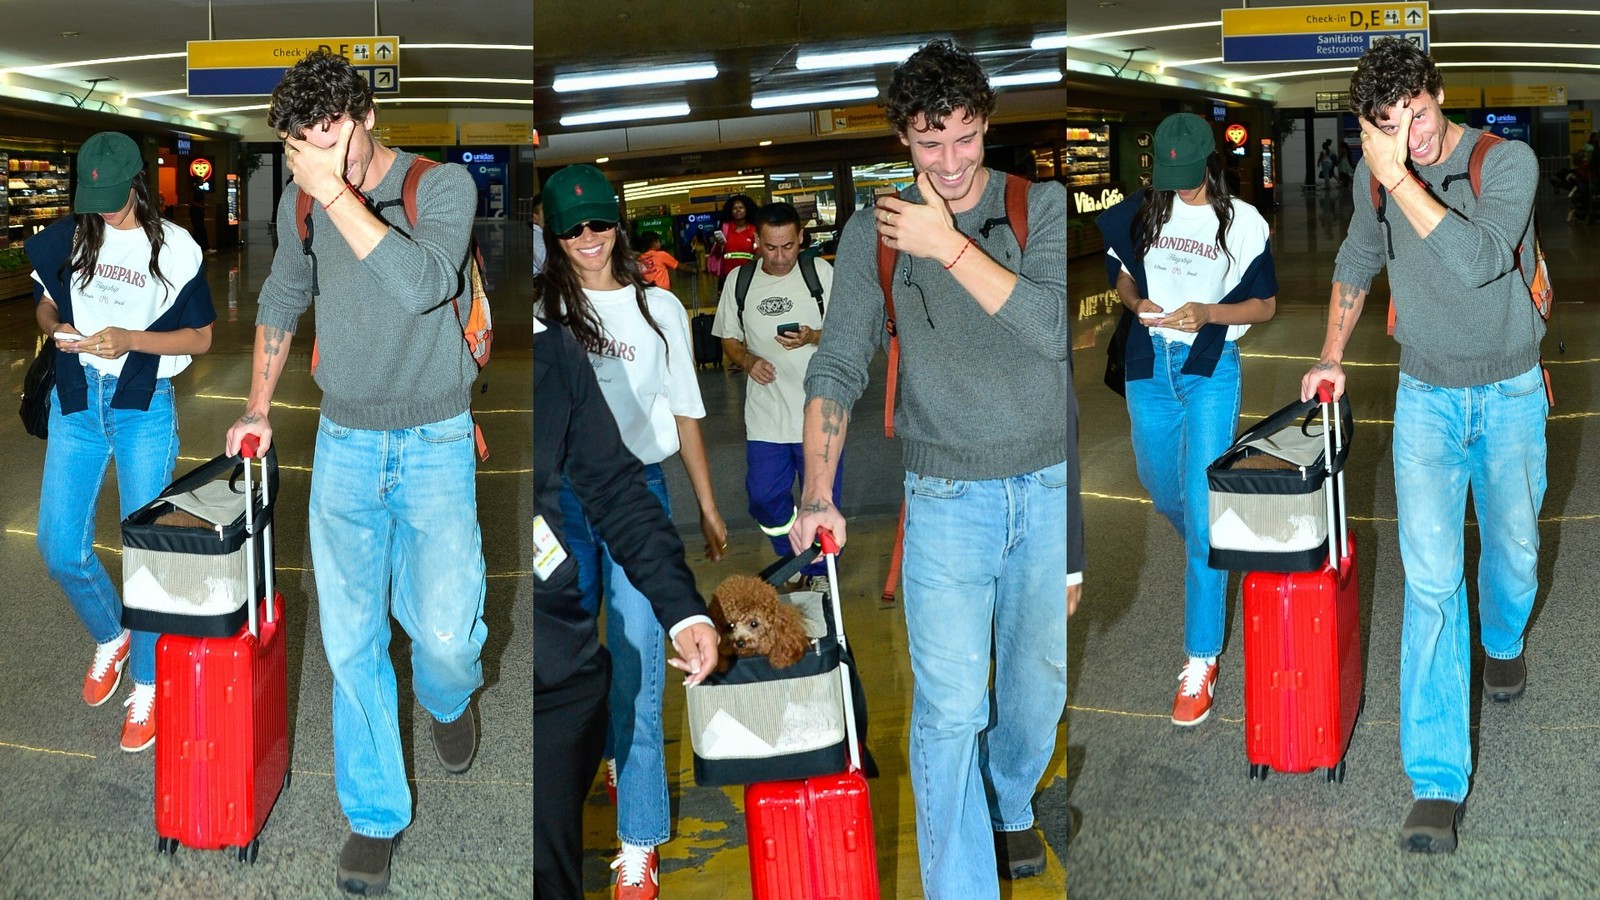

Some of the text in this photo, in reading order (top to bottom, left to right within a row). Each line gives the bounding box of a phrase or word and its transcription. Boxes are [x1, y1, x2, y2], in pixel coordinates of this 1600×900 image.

[1306, 10, 1380, 30] Check-in D,E
[1317, 34, 1363, 44] Sanitários
[1316, 45, 1364, 54] Restrooms
[1074, 191, 1096, 214] Vila
[1168, 253, 1192, 265] Flagship
[95, 281, 119, 294] Flagship
